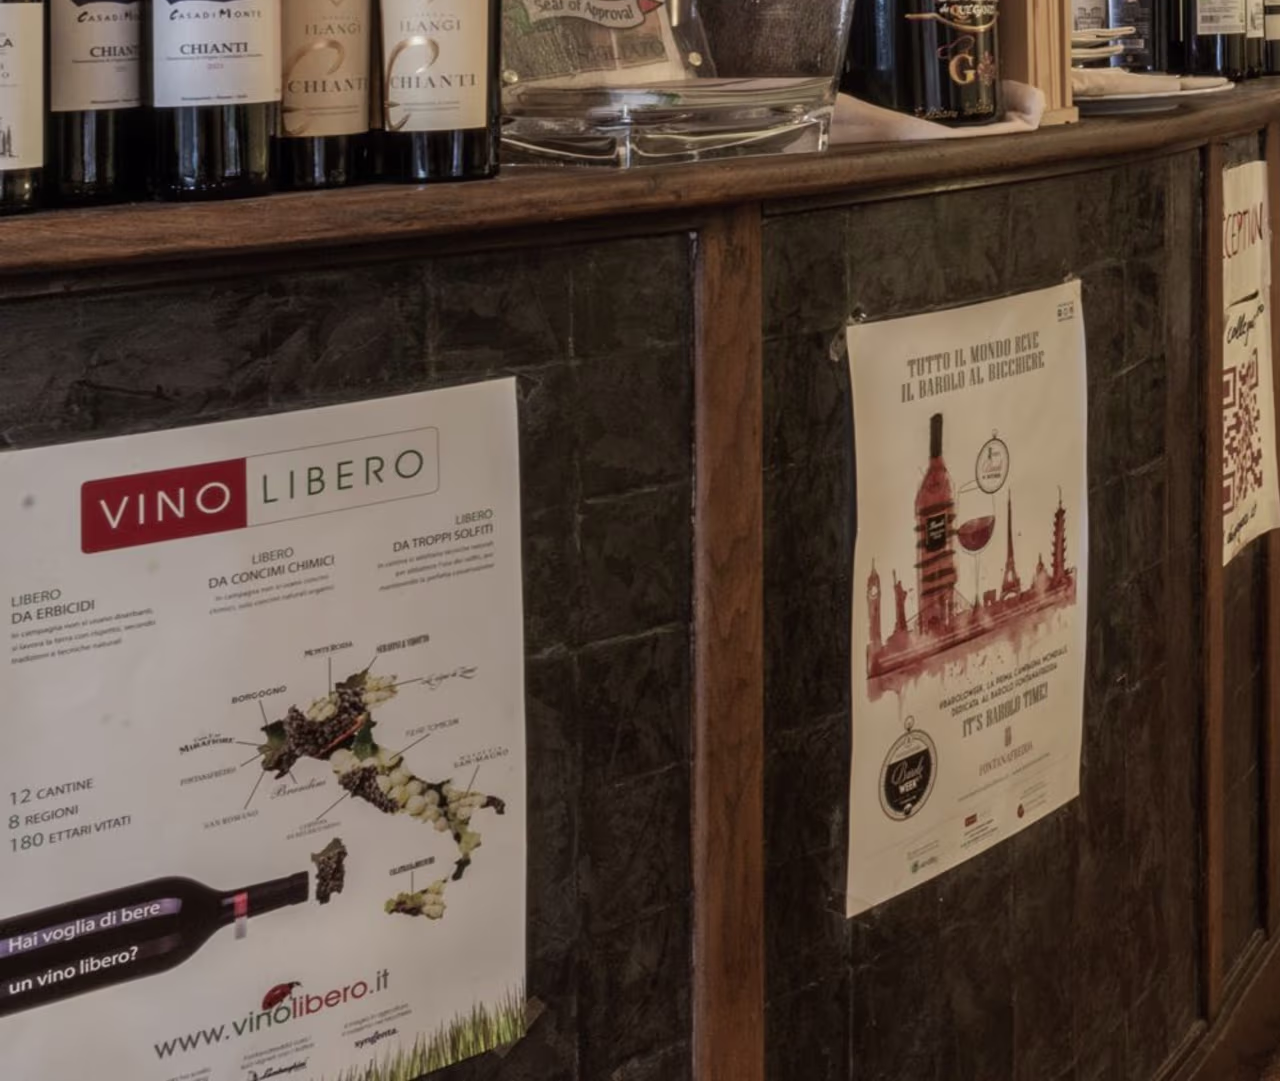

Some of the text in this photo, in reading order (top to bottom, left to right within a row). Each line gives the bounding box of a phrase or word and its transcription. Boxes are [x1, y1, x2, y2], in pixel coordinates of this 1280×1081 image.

[585, 2, 634, 20] Approval
[180, 41, 248, 55] CHIANTI
[287, 77, 368, 94] CHIANTI
[389, 73, 477, 90] CHIANTI
[907, 351, 951, 378] TUTTO
[955, 348, 967, 368] IL
[970, 337, 1012, 364] MONDO
[900, 350, 1046, 404] IL BAROLO AL BICCHIERE
[99, 449, 425, 529] VINO LIBERO
[455, 508, 494, 525] LIBERO
[392, 523, 494, 553] DA TROPPI SOLFITI
[252, 546, 294, 565] LIBERO
[208, 554, 335, 589] DA CONCIMI CHIMICI
[11, 588, 62, 608] LIBERO
[11, 599, 96, 625] DA ERBICIDI
[231, 684, 287, 705] BORGOGNO
[9, 777, 95, 806] 12 CANTINE
[8, 804, 79, 830] 8 REGIONI
[9, 815, 132, 853] 180 ETTARI VITATI
[9, 903, 161, 953] Hai voglia di bere
[8, 945, 139, 995] un vino libero?
[153, 968, 390, 1059] www.vinolibero.it
